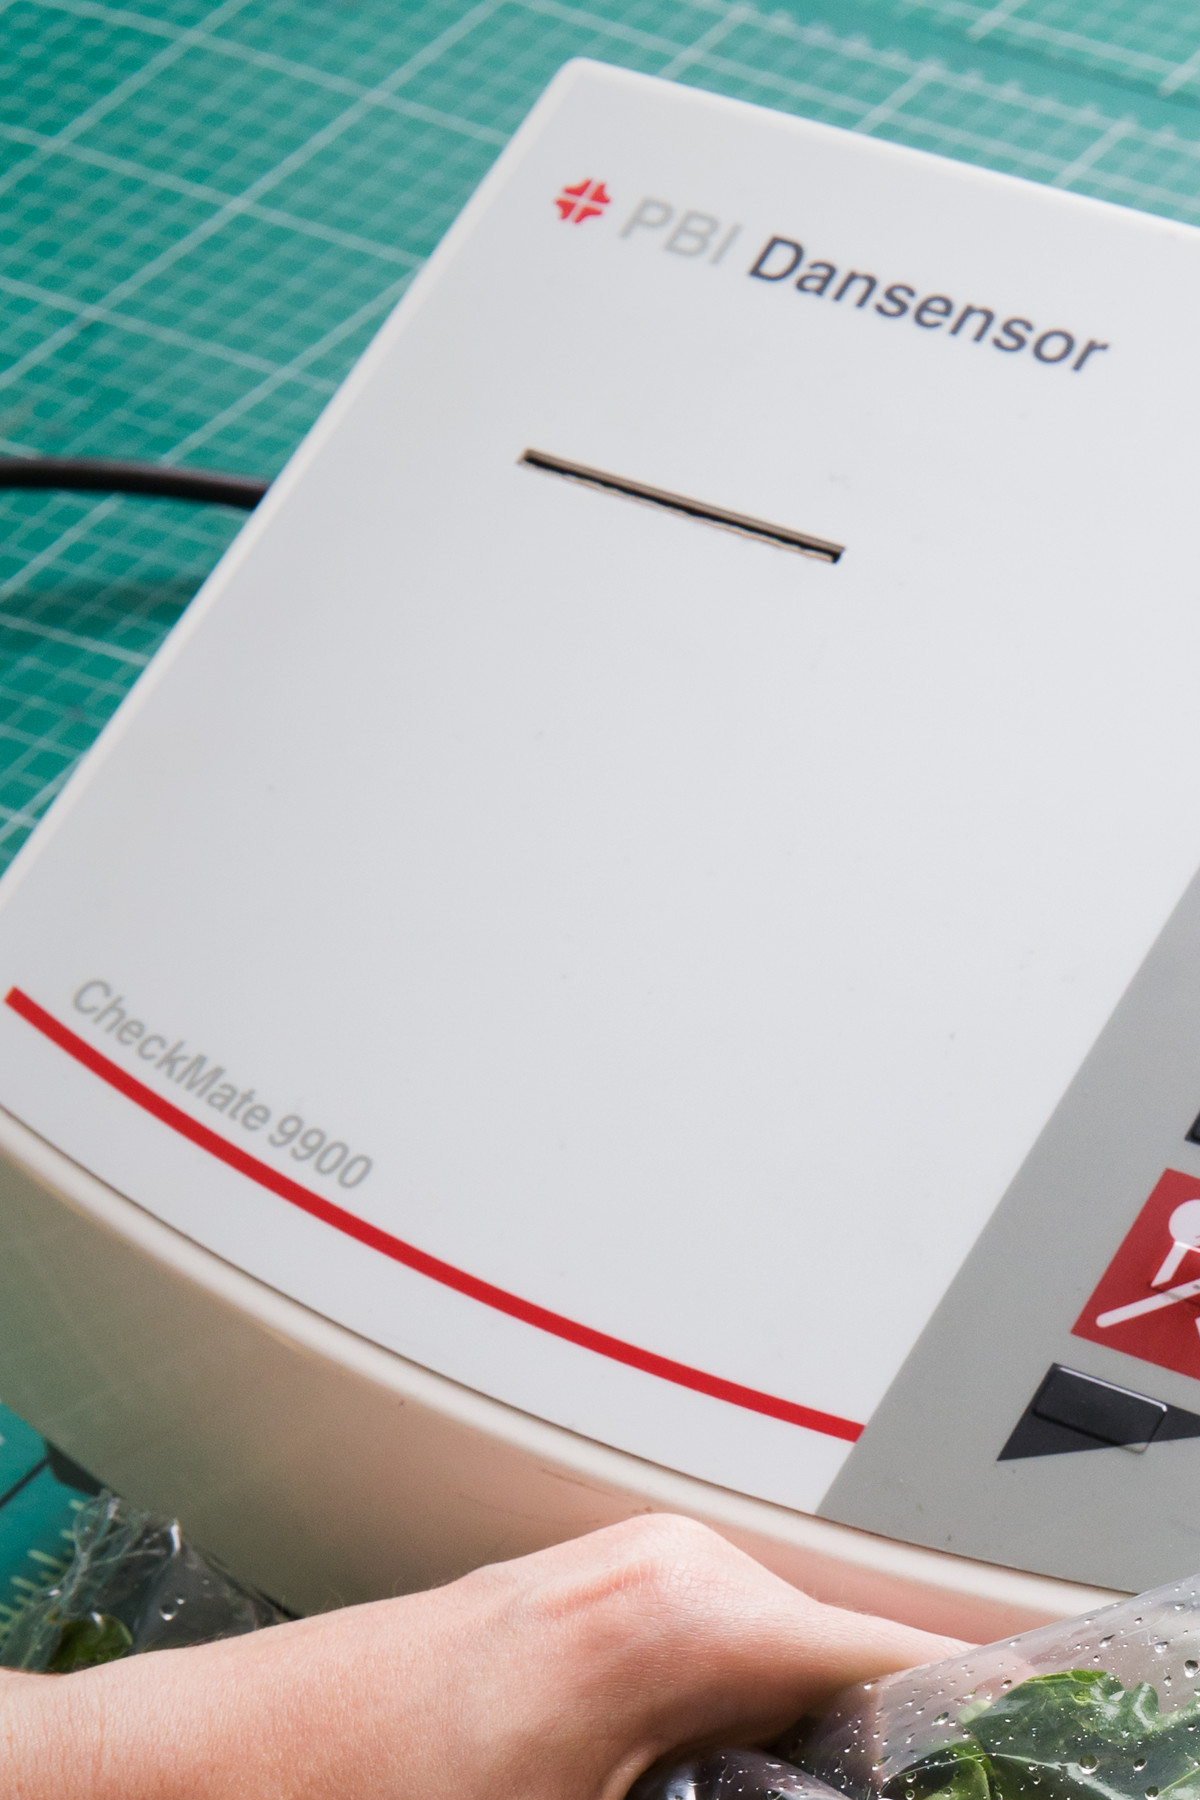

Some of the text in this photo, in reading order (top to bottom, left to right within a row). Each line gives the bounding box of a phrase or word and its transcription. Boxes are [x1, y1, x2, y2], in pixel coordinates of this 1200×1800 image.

[621, 195, 1109, 373] PBI Dansensor
[72, 979, 374, 1190] CheckMate 9900
